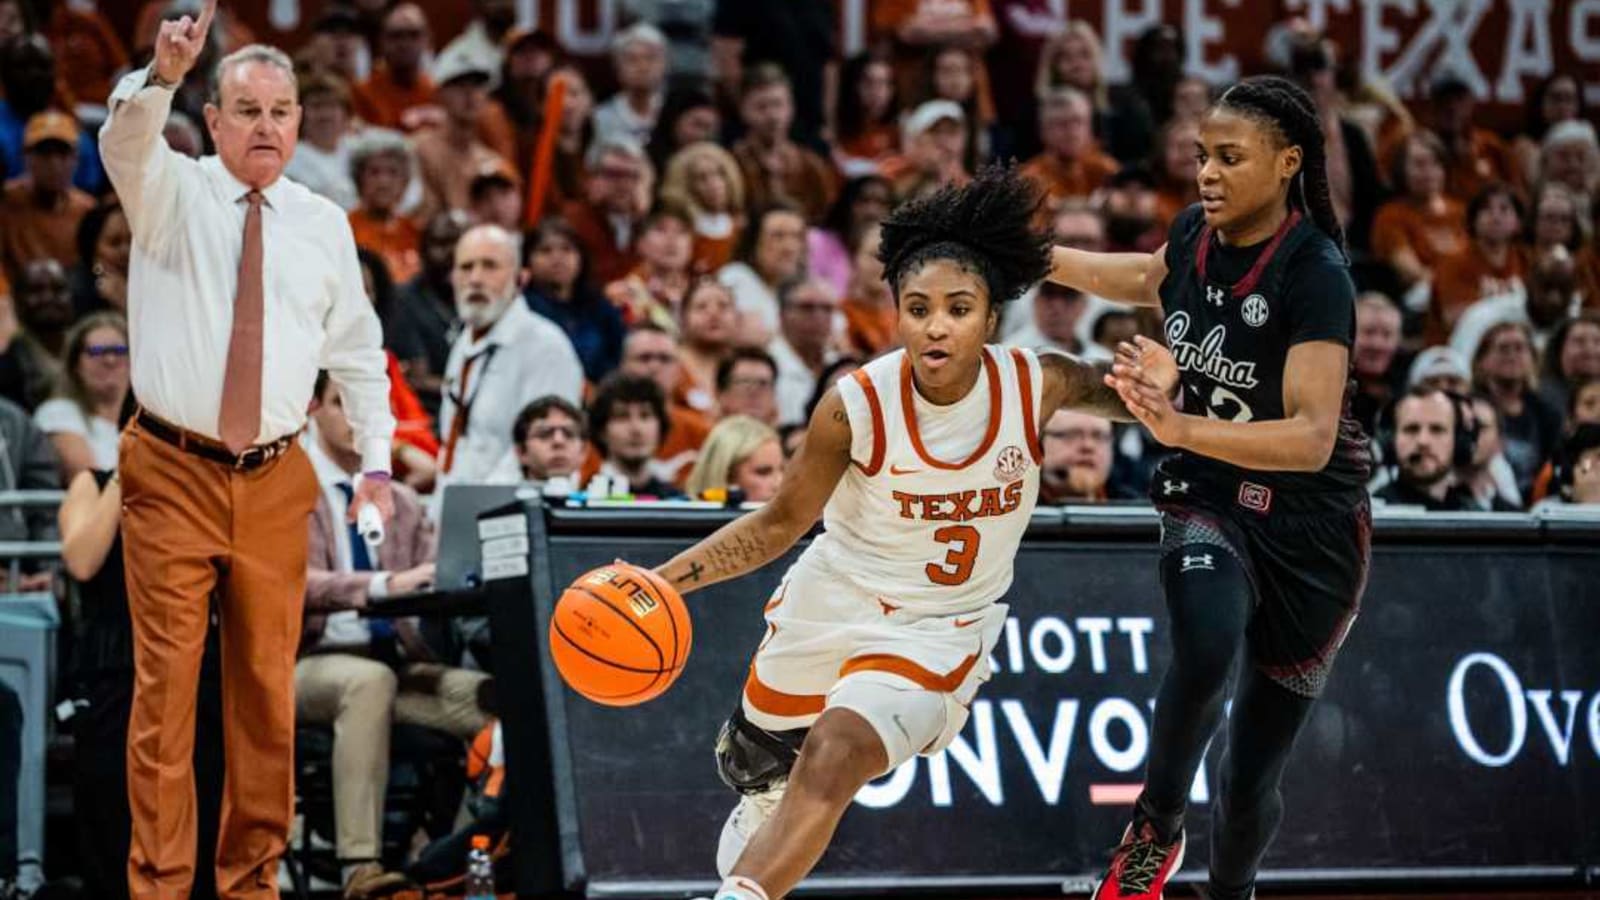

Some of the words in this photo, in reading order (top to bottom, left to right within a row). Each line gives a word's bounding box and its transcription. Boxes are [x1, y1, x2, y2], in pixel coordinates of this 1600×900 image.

[1285, 0, 1600, 101] EXAS
[1243, 296, 1267, 324] SEC
[892, 479, 1023, 521] TEXAS
[925, 525, 980, 586] 3
[988, 617, 1154, 674] IOTT
